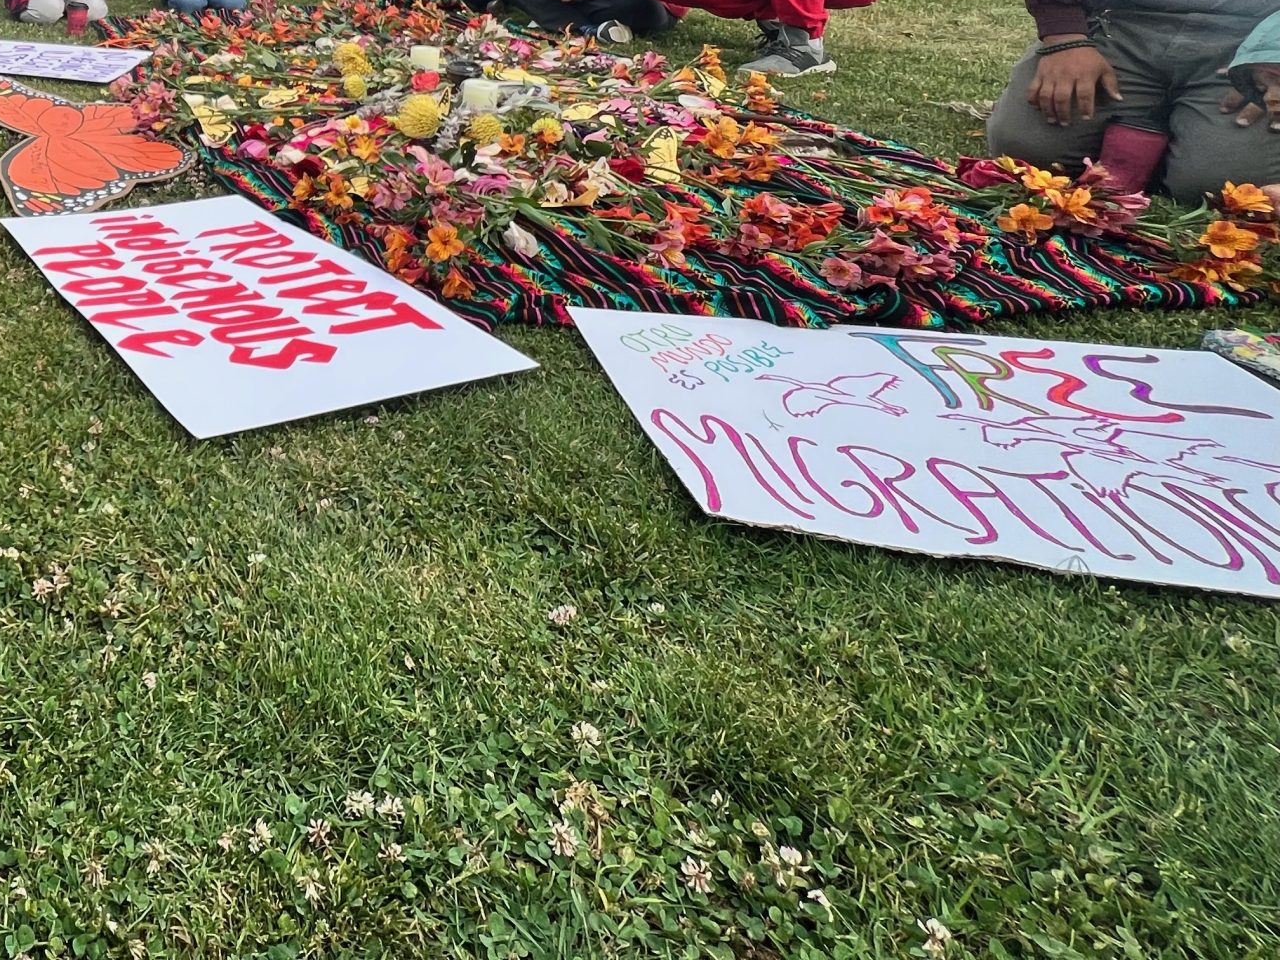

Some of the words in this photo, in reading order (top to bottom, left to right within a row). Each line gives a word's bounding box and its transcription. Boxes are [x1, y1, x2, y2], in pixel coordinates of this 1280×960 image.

[620, 323, 693, 352] OTRO
[650, 333, 733, 373] MUNDO
[668, 369, 705, 390] ES
[704, 340, 794, 383] POSIBLE
[848, 332, 1273, 423] FREE
